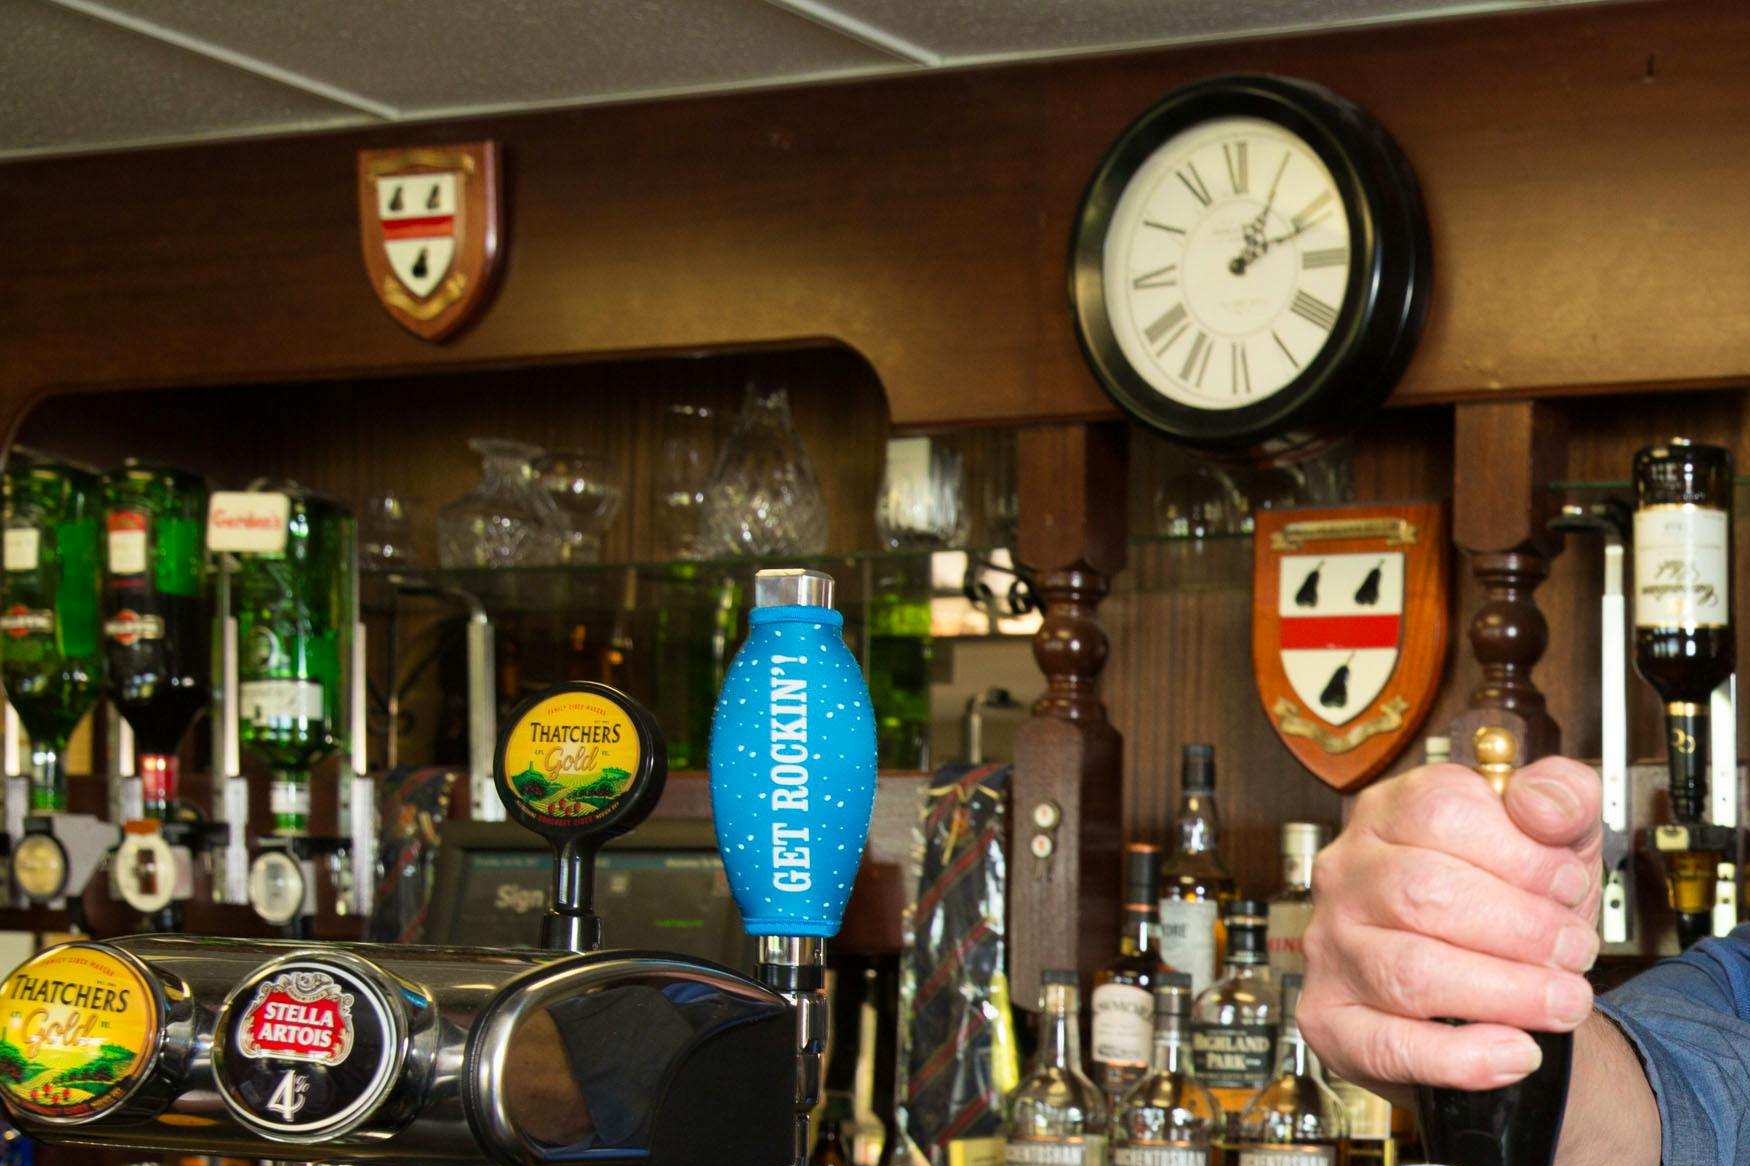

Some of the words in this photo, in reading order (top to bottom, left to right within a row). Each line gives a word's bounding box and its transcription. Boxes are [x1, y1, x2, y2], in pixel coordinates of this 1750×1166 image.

[531, 722, 621, 744] THATCHERS
[770, 654, 809, 812] ROCKIN'!
[544, 745, 599, 781] Gold
[772, 822, 812, 893] GET
[10, 974, 130, 1014] THATCHERS
[264, 1001, 335, 1029] STELLA
[22, 1007, 98, 1059] Gold
[258, 1023, 333, 1048] ARTOIS
[1193, 1033, 1271, 1053] HIGHLAND
[1206, 1053, 1247, 1071] PARK
